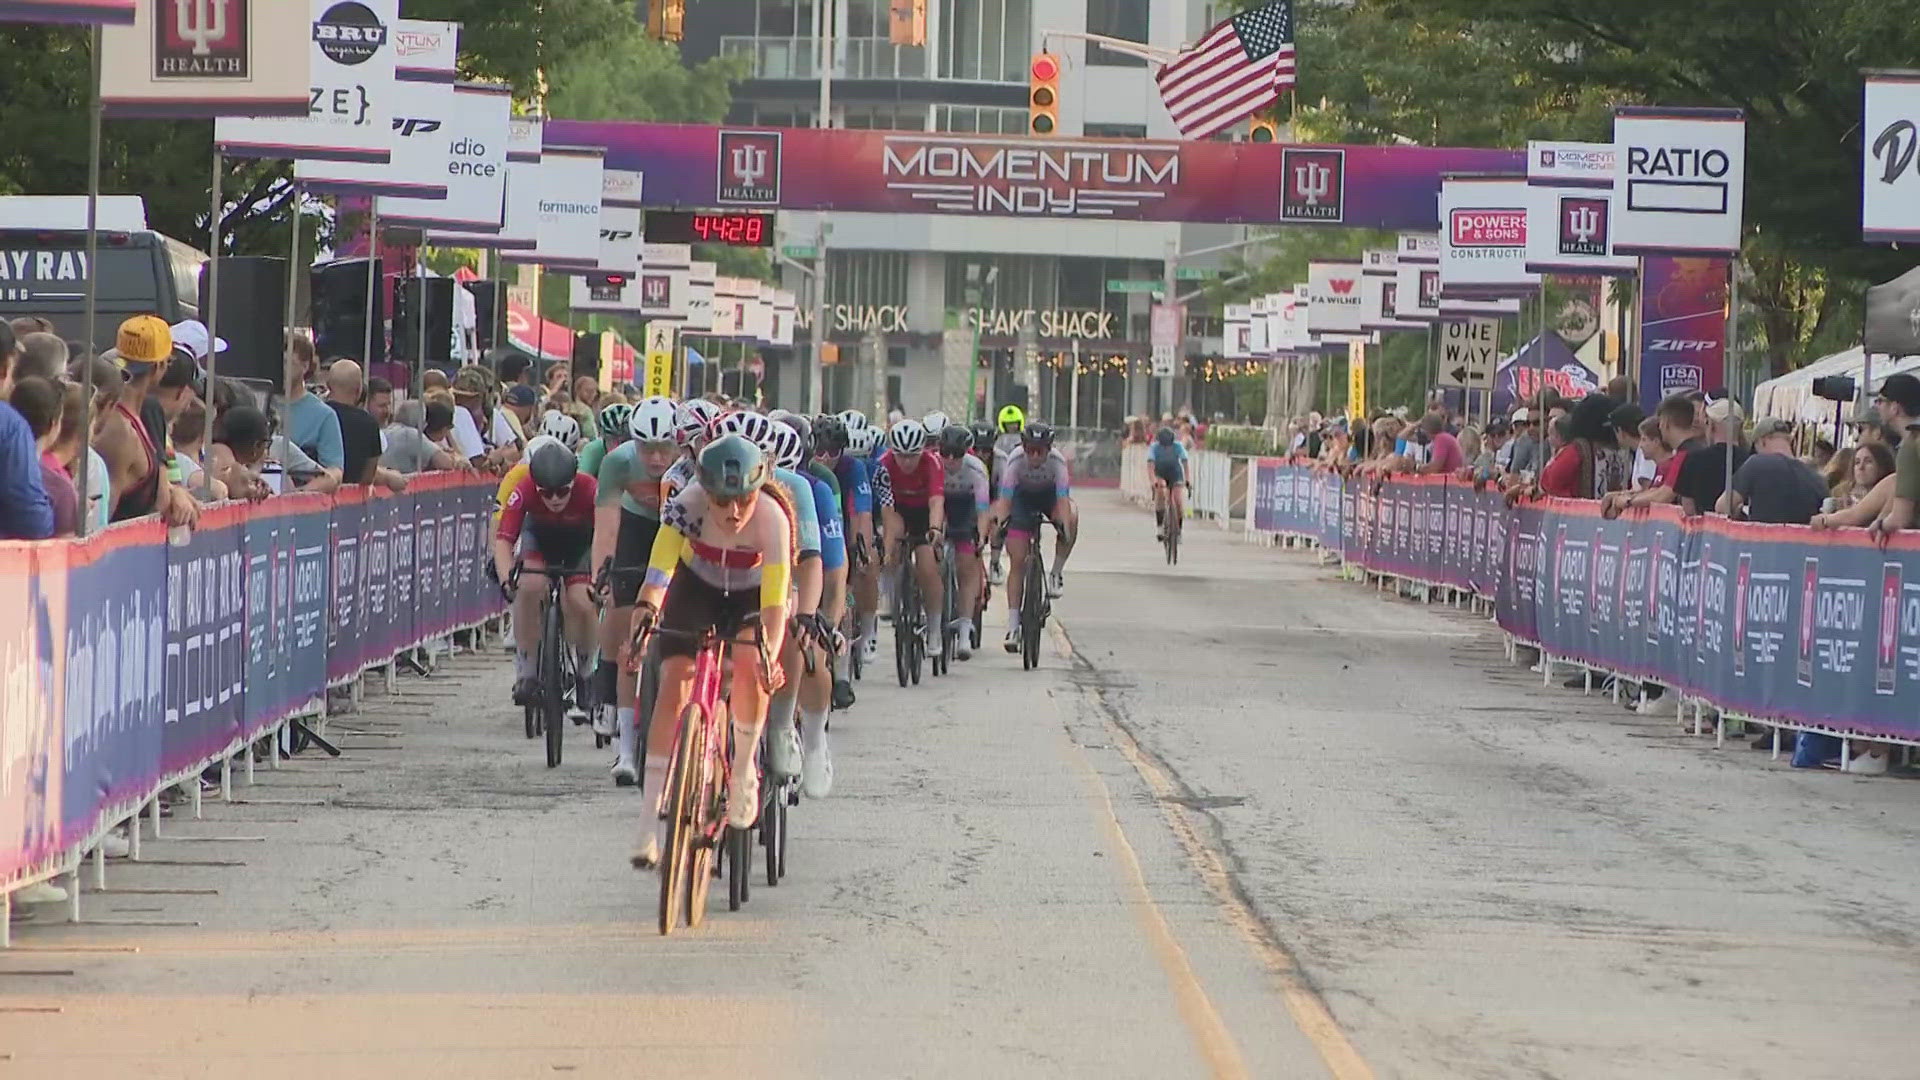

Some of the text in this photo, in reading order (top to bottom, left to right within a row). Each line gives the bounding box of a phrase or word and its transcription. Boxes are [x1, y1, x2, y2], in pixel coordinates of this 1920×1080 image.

[316, 25, 383, 42] BRU
[162, 58, 241, 72] HEALTH
[883, 144, 1179, 185] MOMENTUM
[1627, 147, 1730, 178] RATIO
[723, 187, 774, 200] HEALTH
[977, 184, 1076, 215] INDY
[1286, 205, 1338, 217] HEALTH
[693, 215, 763, 243] 44:28
[1486, 229, 1519, 241] SONS
[1562, 242, 1604, 253] HEALTH
[36, 250, 88, 280] RAY
[835, 304, 909, 333] SHACK
[1039, 310, 1113, 340] SHACK
[1450, 322, 1491, 341] ONE
[1446, 344, 1491, 365] WAY
[1648, 339, 1717, 351] ZIPP
[1664, 368, 1698, 379] USA
